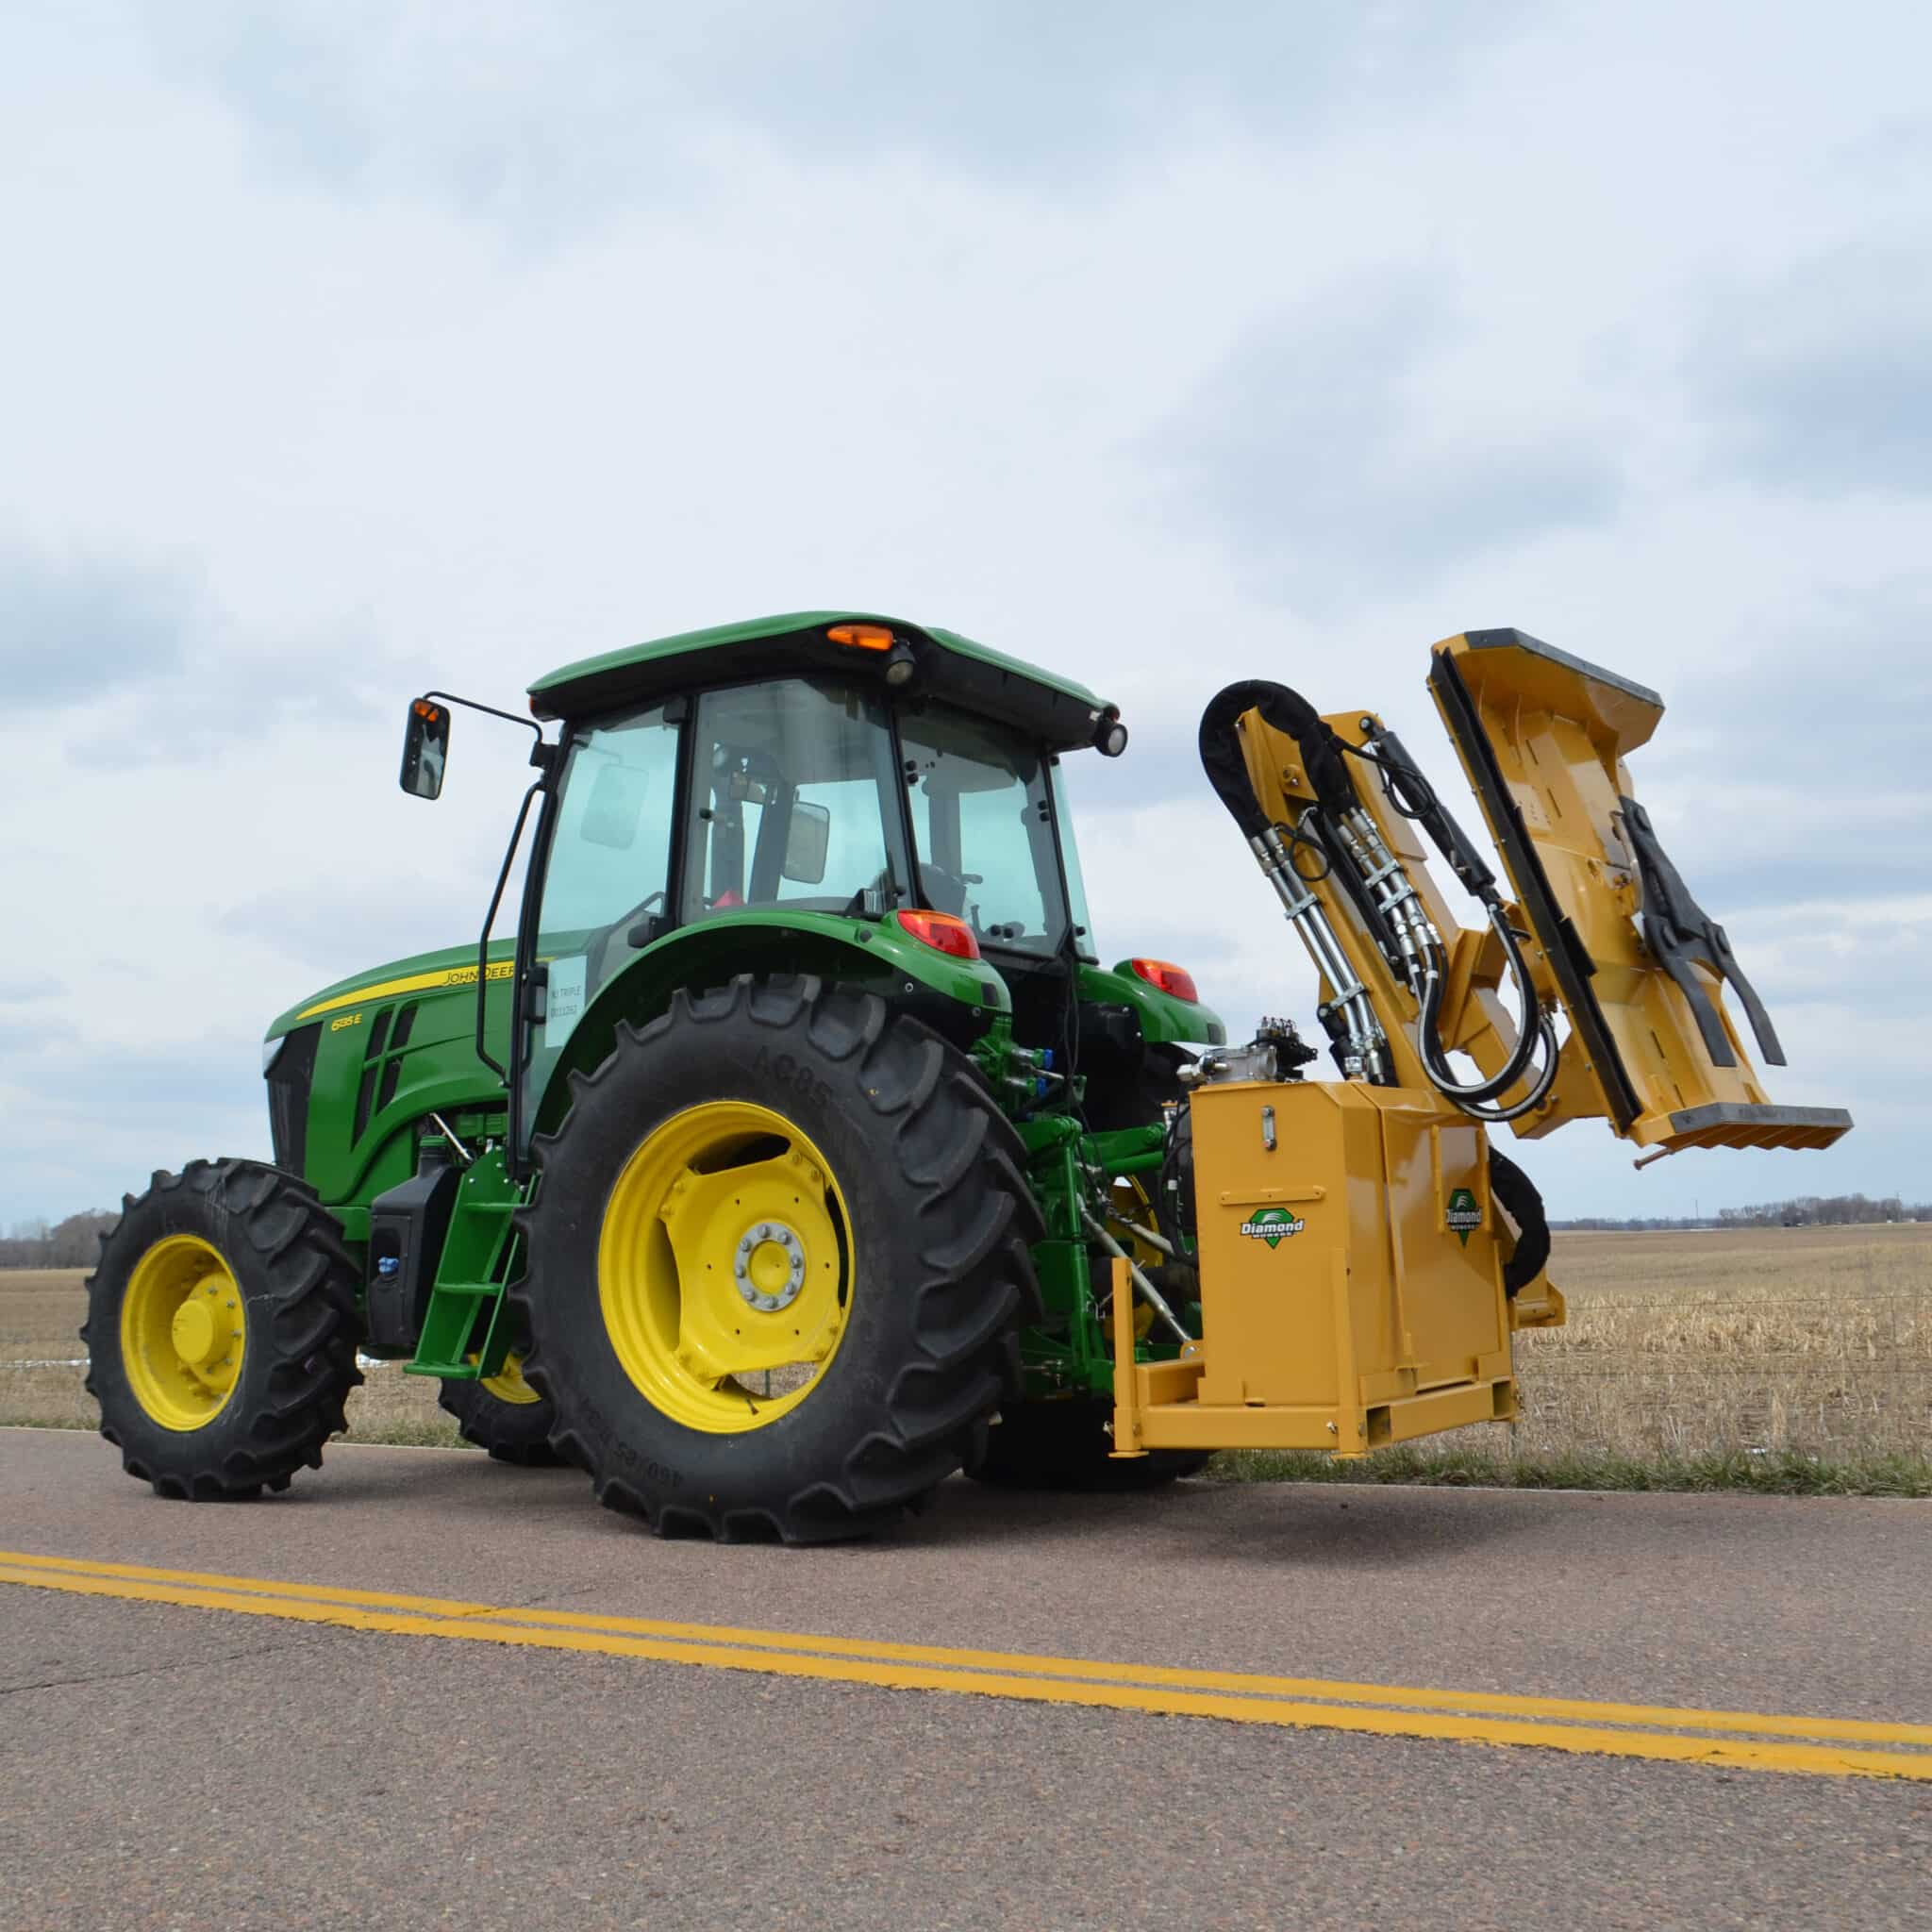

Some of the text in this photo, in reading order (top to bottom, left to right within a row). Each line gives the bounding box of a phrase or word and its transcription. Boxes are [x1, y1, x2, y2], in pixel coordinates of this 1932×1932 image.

[442, 965, 515, 984] JOHN DEER
[1445, 1208, 1482, 1223] Diamond
[1241, 1219, 1304, 1235] Diamond
